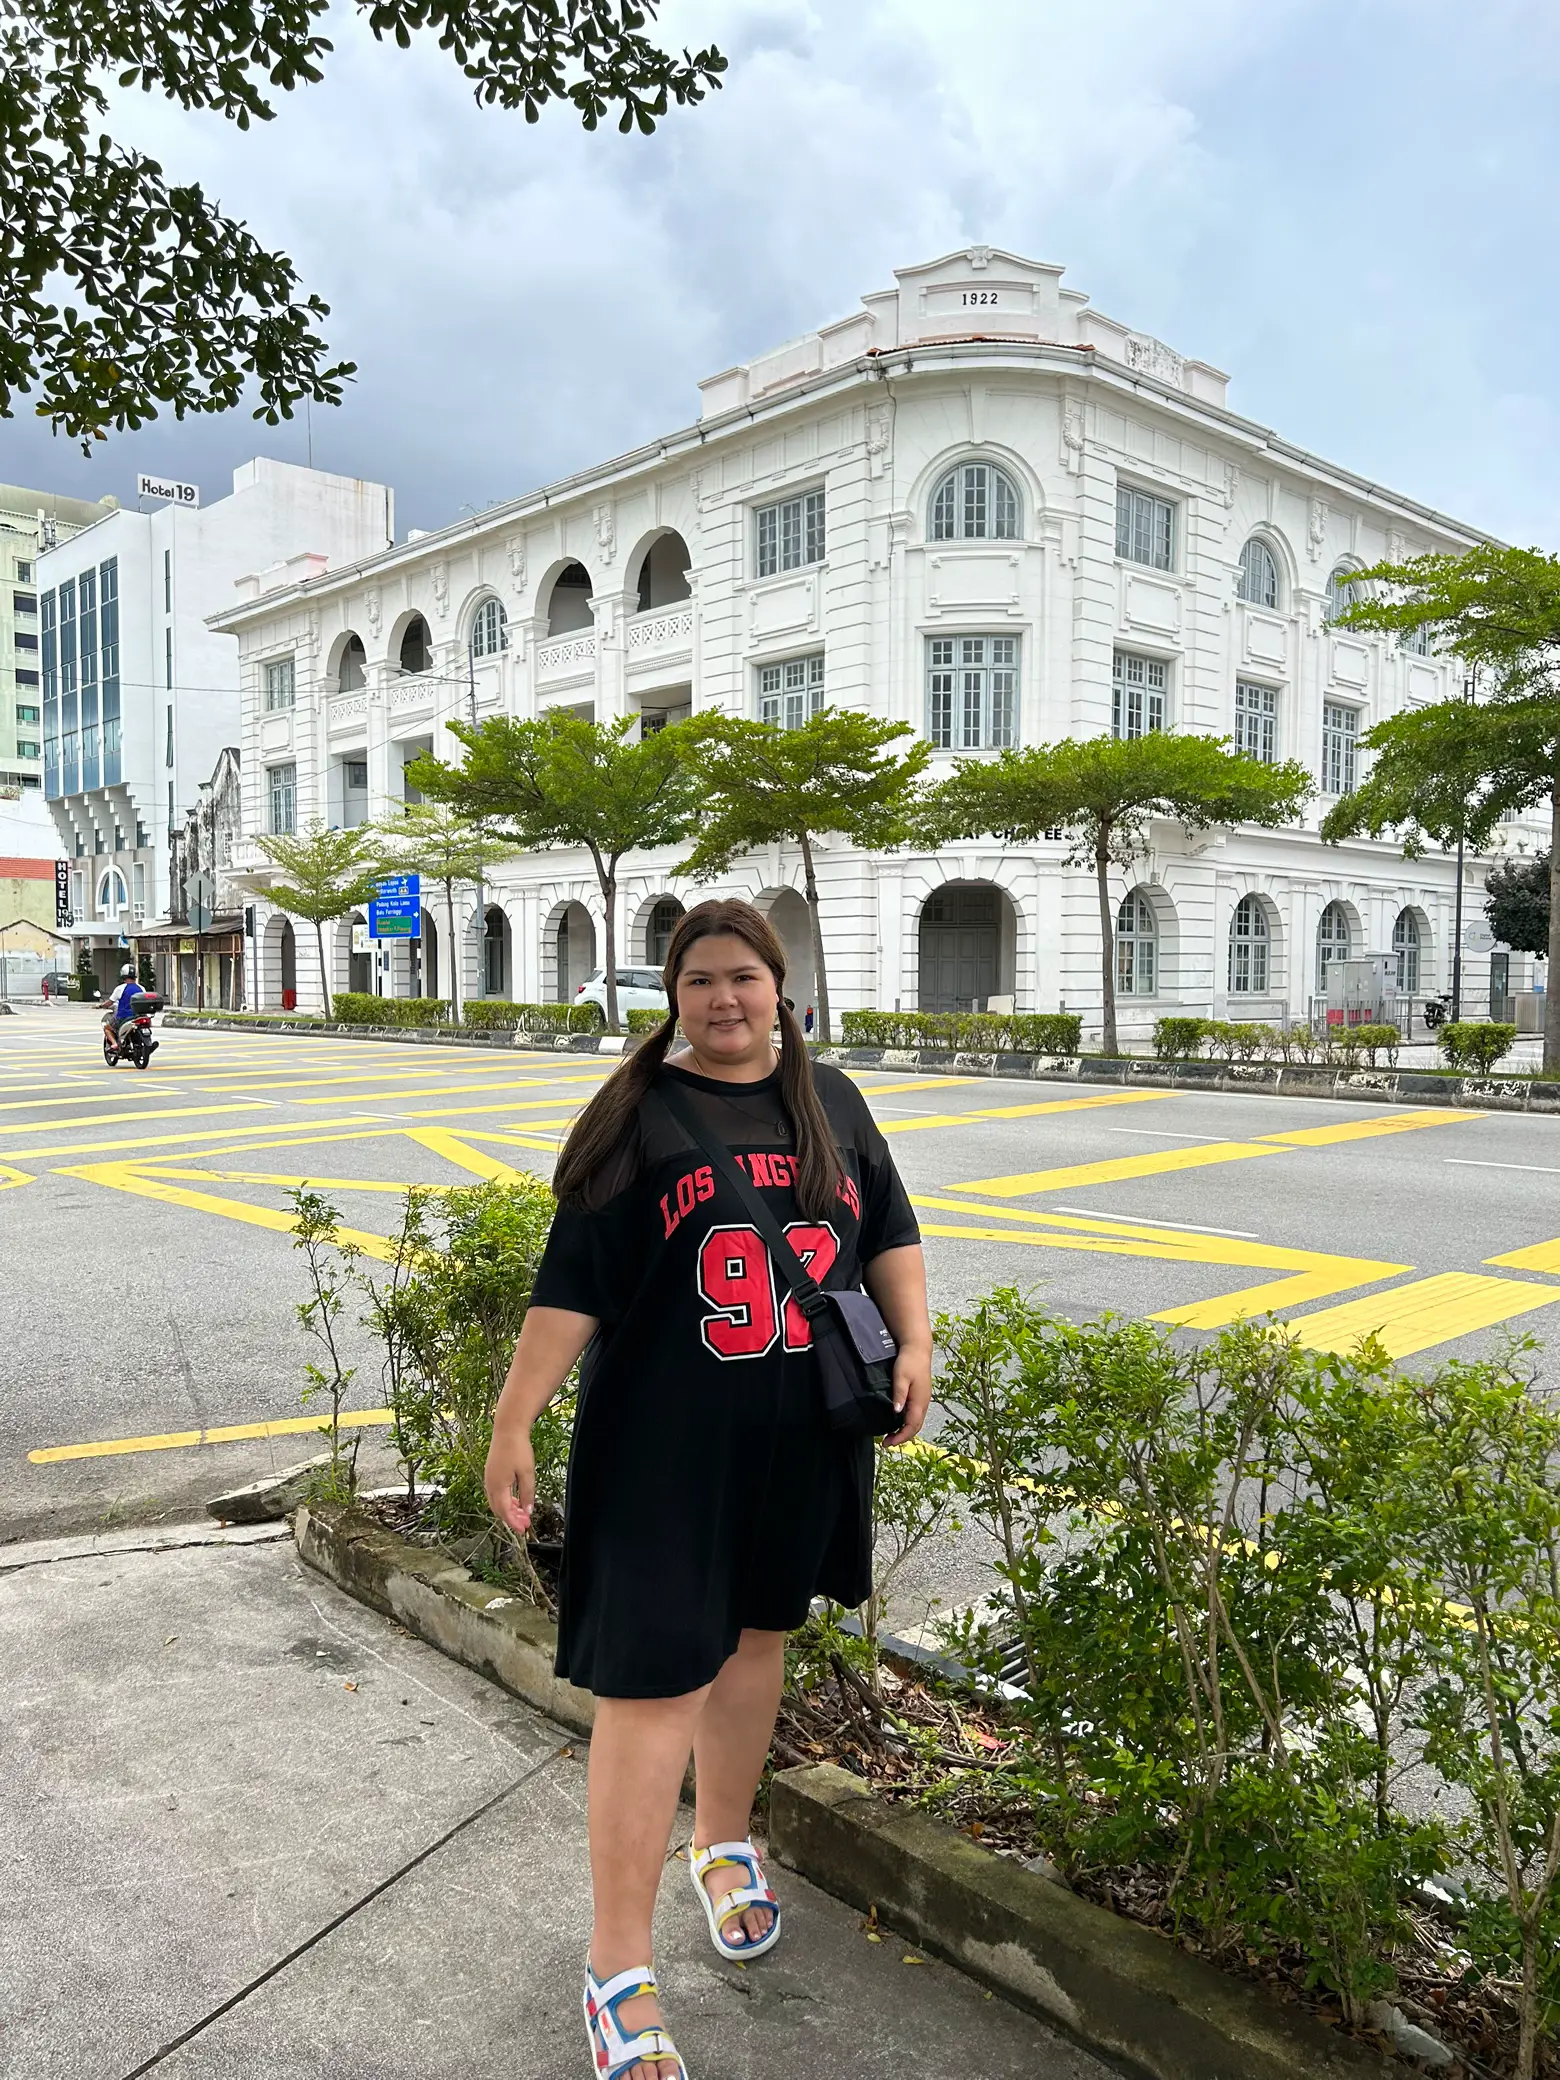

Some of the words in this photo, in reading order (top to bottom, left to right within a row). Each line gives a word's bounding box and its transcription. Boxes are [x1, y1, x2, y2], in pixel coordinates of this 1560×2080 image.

[962, 292, 998, 306] 1922
[142, 478, 175, 498] Hotel
[176, 484, 196, 502] 19
[57, 862, 67, 908] HOTEL
[659, 1165, 716, 1240] LOS
